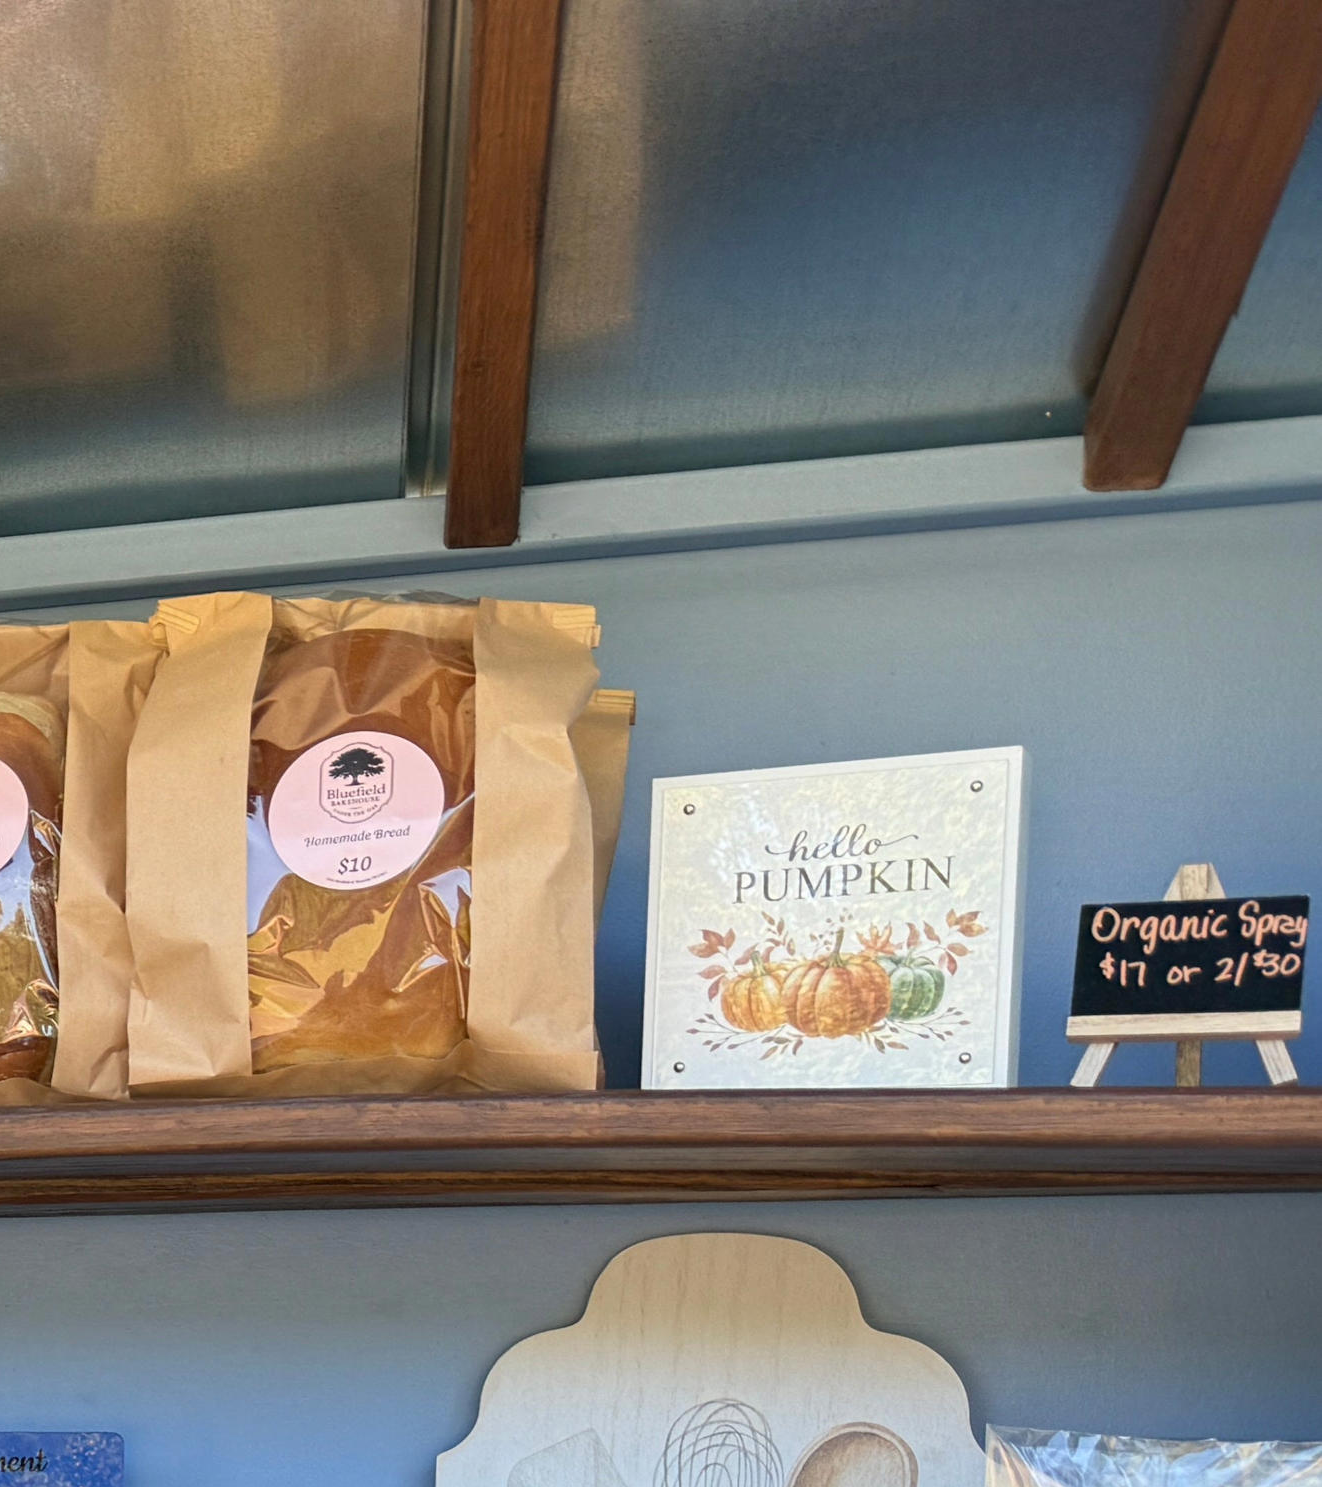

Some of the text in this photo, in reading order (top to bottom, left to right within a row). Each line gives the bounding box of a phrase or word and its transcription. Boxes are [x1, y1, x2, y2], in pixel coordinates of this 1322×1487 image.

[327, 783, 386, 800] Bluefield
[304, 826, 410, 848] Homemade Bread
[765, 823, 919, 862] hello
[338, 856, 372, 875] $10
[732, 855, 957, 904] PUMPKIN
[1091, 906, 1228, 955] Organic
[1099, 952, 1147, 987] $17
[1166, 965, 1202, 985] or
